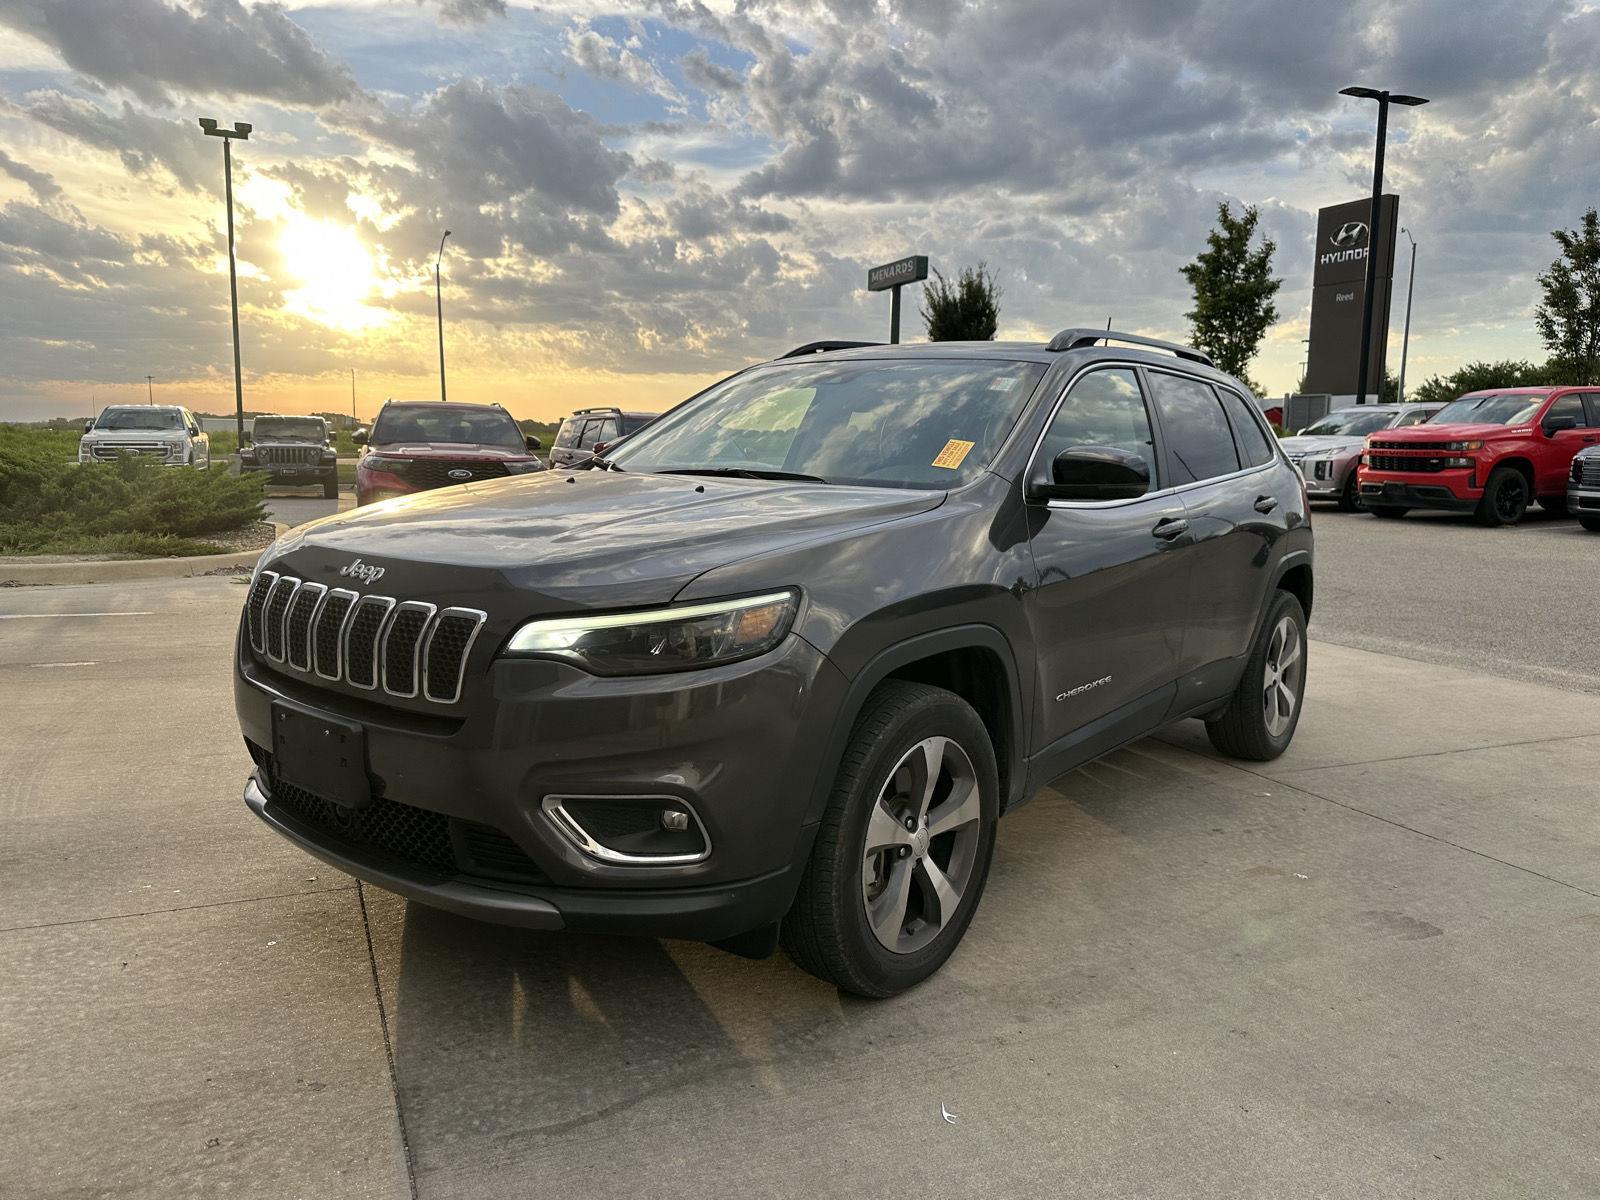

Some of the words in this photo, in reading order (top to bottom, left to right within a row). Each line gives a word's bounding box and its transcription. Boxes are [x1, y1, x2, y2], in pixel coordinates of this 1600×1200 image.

[1320, 247, 1369, 265] HYUNDA
[871, 260, 914, 283] MENARDS
[1335, 291, 1354, 302] Reed
[339, 558, 385, 586] Jeep
[1056, 675, 1112, 702] CHEROKEE
